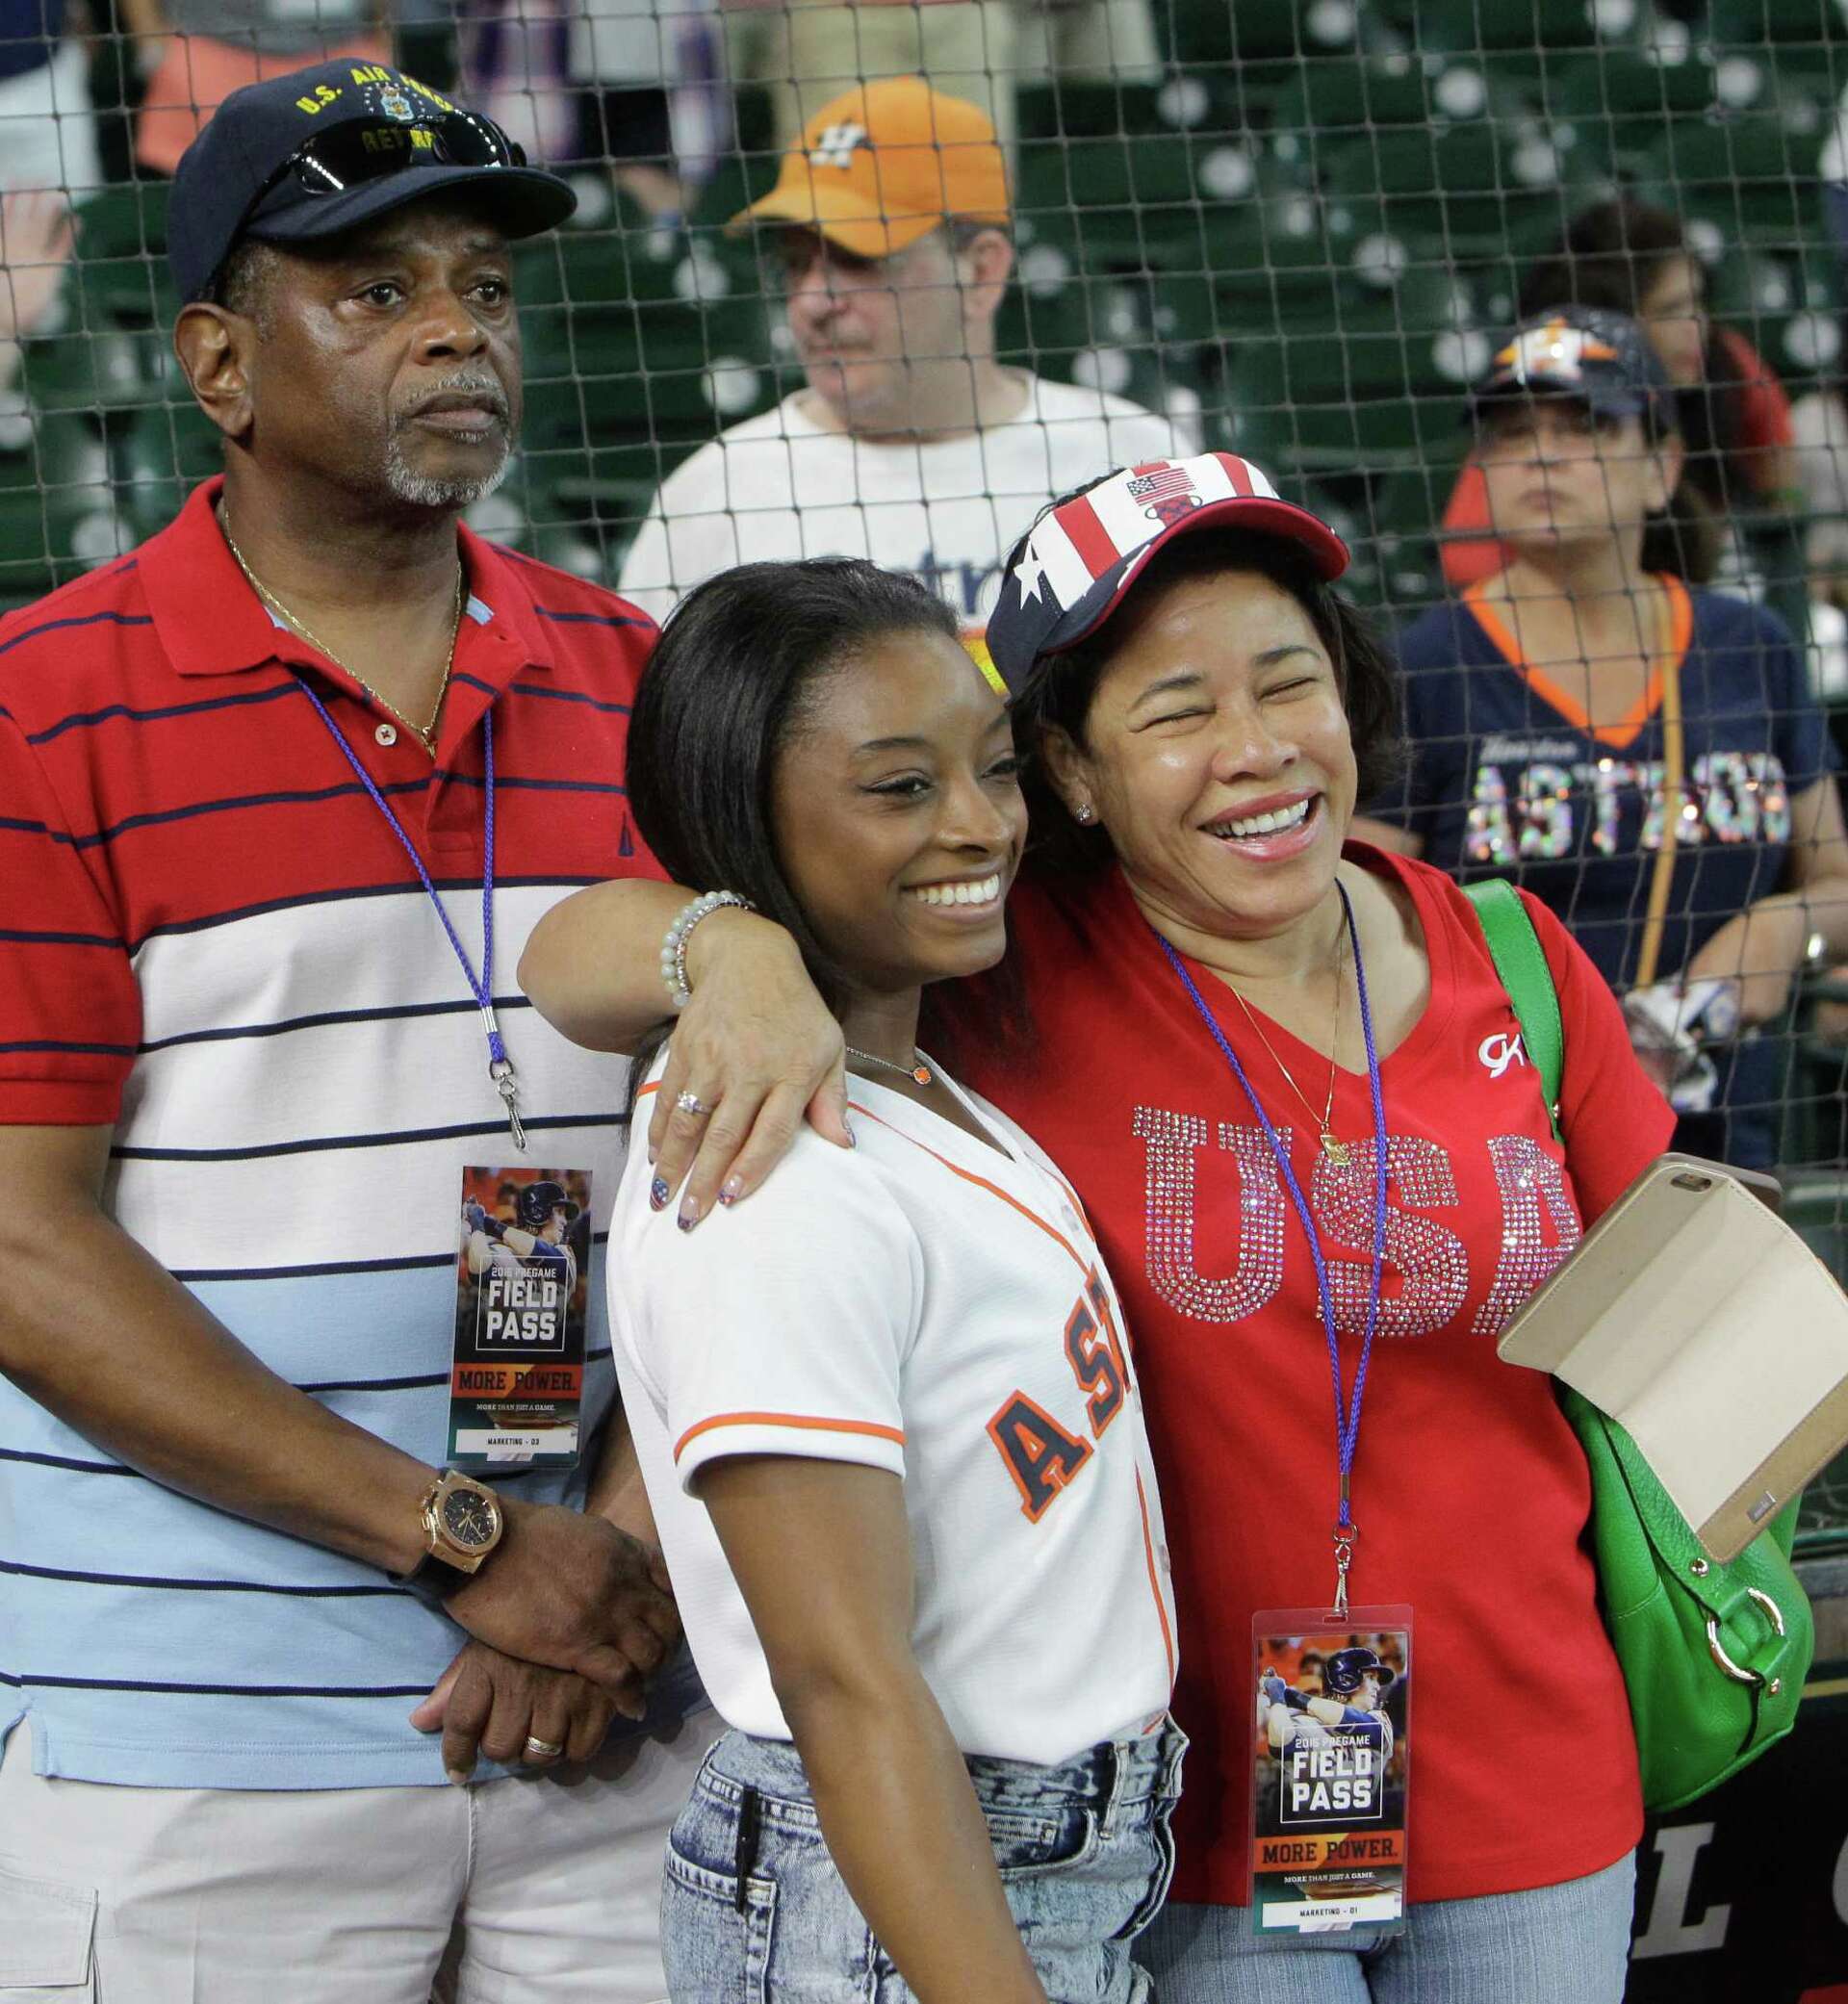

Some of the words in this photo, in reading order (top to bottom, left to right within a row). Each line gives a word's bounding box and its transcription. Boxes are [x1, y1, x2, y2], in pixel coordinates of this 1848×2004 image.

[295, 85, 343, 115] U.S.
[350, 65, 392, 86] AIR
[516, 1267, 557, 1278] PREGAME
[488, 1279, 557, 1308] FIELD
[486, 1311, 556, 1341] PASS
[458, 1370, 507, 1391] MORE
[514, 1371, 577, 1392] POWER.
[487, 1437, 524, 1446] MARKETING
[1322, 1734, 1371, 1747] PREGAME
[1293, 1748, 1372, 1779] FIELD
[1292, 1779, 1372, 1811] PASS
[1262, 1842, 1318, 1863] MORE
[1326, 1837, 1399, 1862] POWER.
[1309, 1874, 1328, 1883] THAN
[1299, 1907, 1341, 1917] MARKETING
